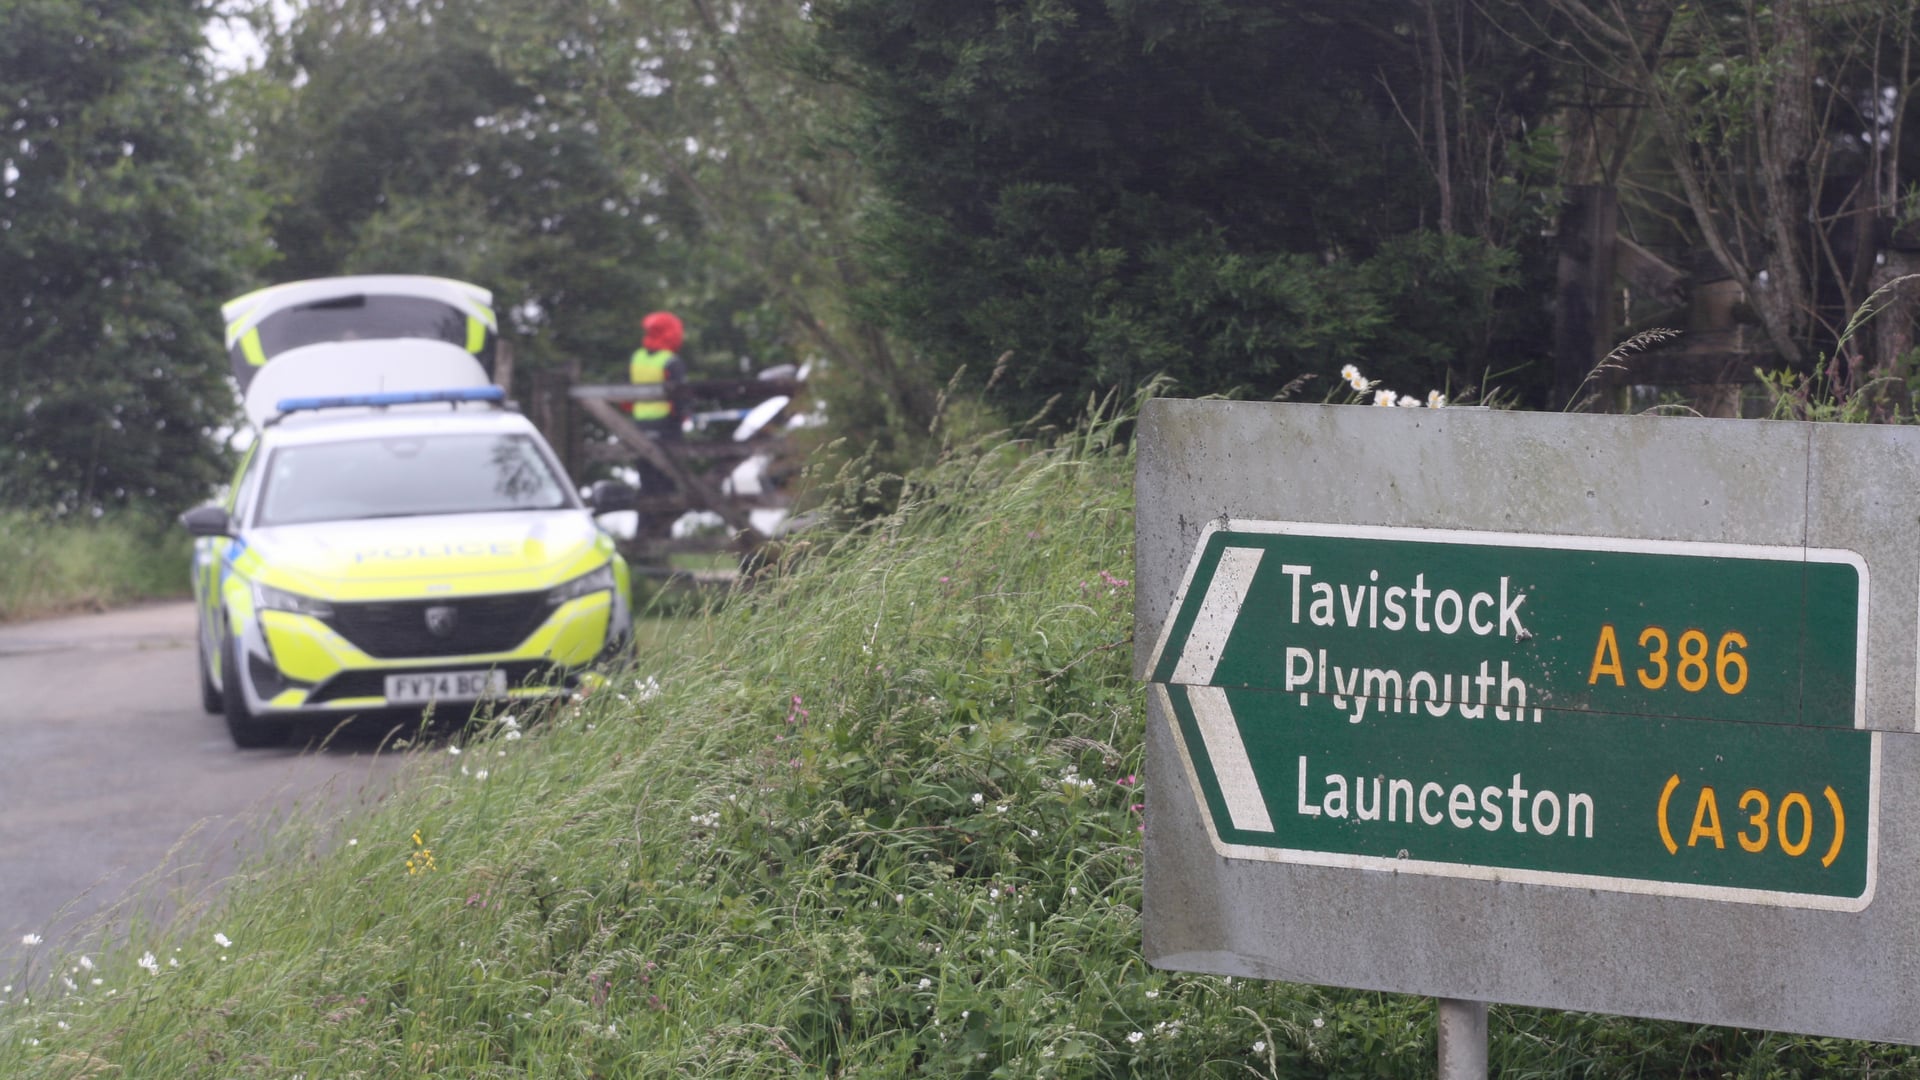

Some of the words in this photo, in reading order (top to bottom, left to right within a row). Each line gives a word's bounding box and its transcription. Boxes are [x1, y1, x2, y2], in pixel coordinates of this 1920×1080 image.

[354, 543, 515, 564] POLICE
[1281, 563, 1528, 640] Tavistock
[395, 676, 449, 697] FV74
[1285, 646, 1542, 724] Plymouth
[1297, 755, 1595, 839] Launceston
